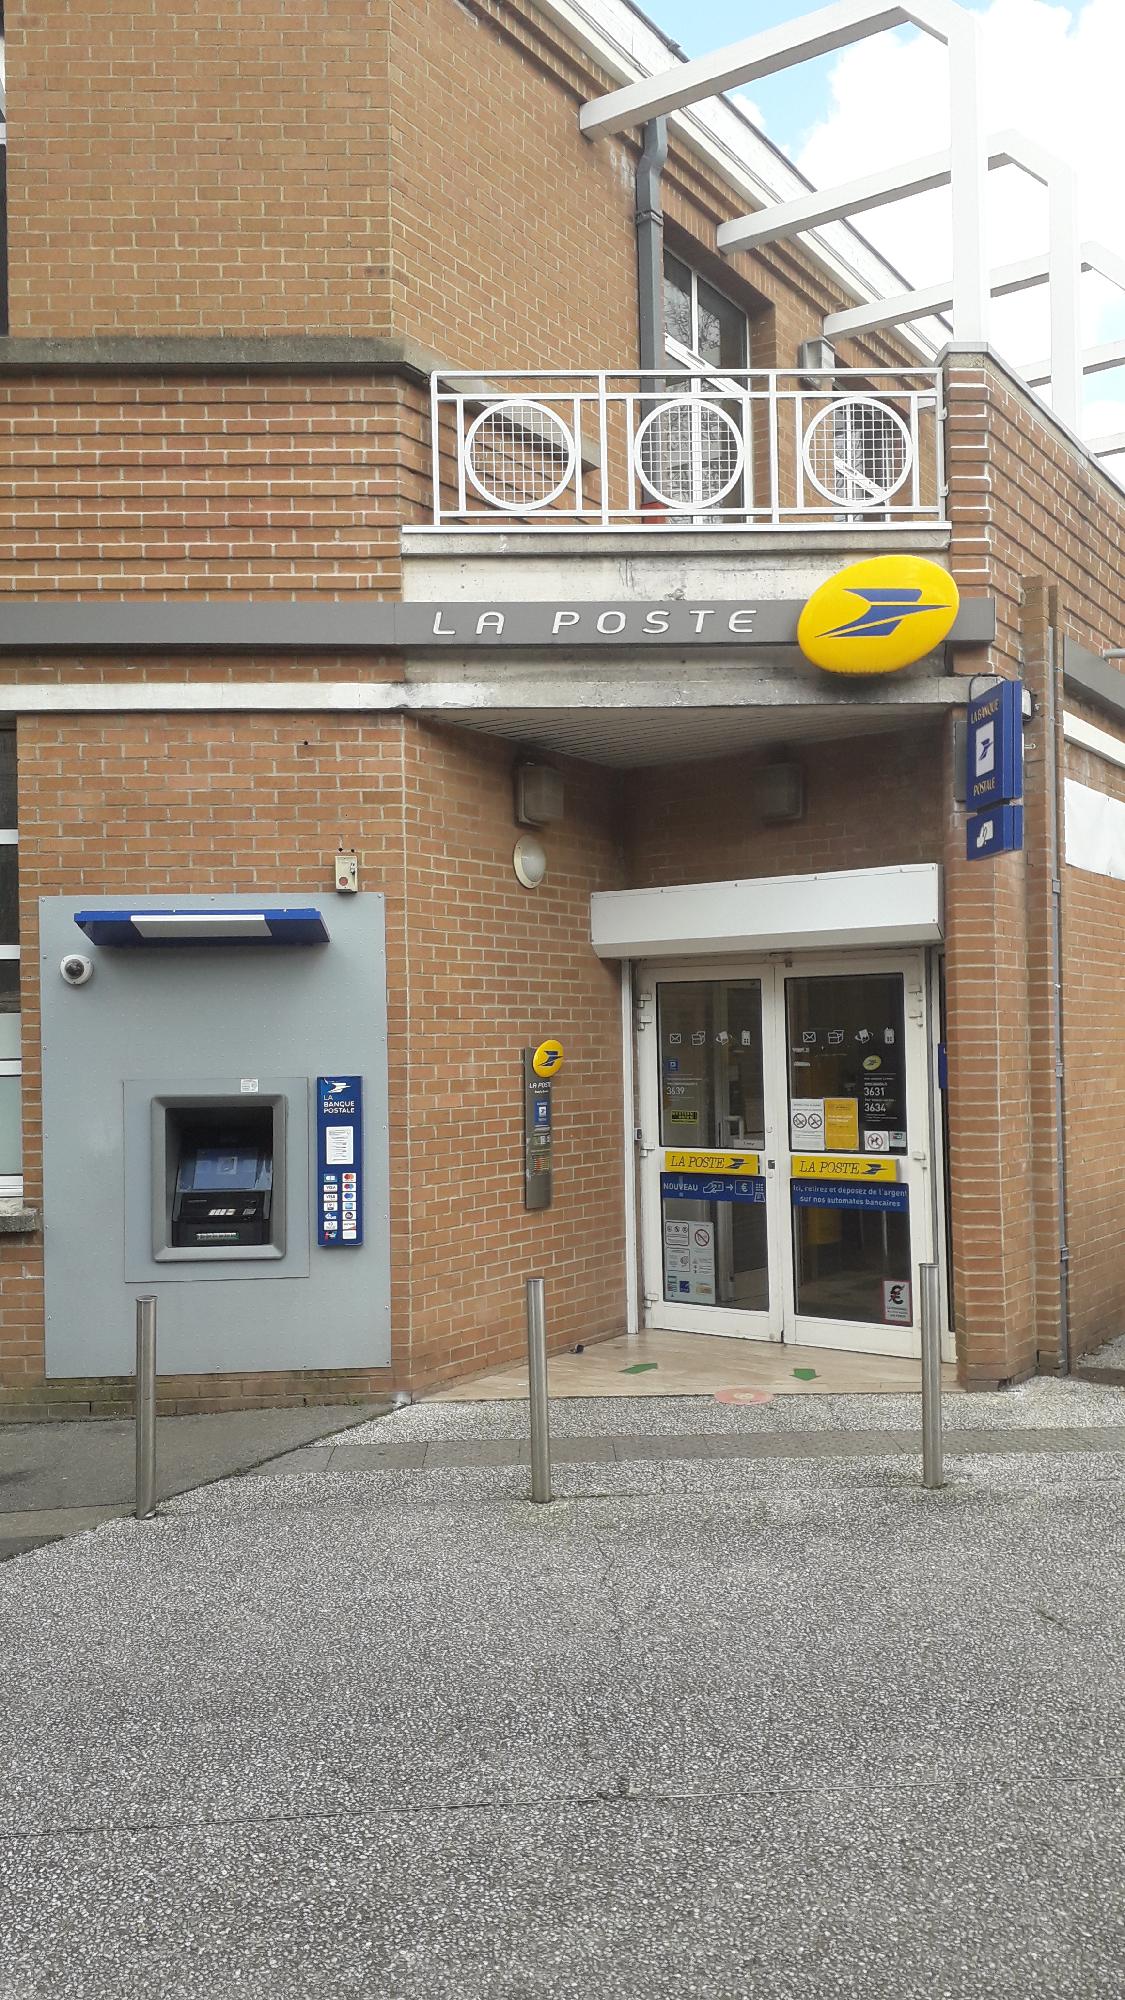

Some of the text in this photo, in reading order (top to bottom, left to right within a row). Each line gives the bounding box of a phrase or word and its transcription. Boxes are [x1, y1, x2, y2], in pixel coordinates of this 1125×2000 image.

[433, 608, 759, 635] LA POSTE
[977, 699, 999, 720] BANQUE
[973, 777, 995, 797] POSTALE
[666, 1086, 685, 1095] 3639
[863, 1086, 885, 1096] 3631
[323, 1100, 355, 1108] BANQUE
[864, 1102, 886, 1112] 3634
[670, 1155, 725, 1169] LA POSTE
[799, 1160, 860, 1174] LA POSTE
[663, 1182, 698, 1192] NOUVEAU
[804, 1185, 828, 1193] retirez
[837, 1186, 867, 1195] déposez
[868, 1188, 877, 1196] de
[827, 1197, 864, 1205] automates
[865, 1198, 901, 1207] bancaires
